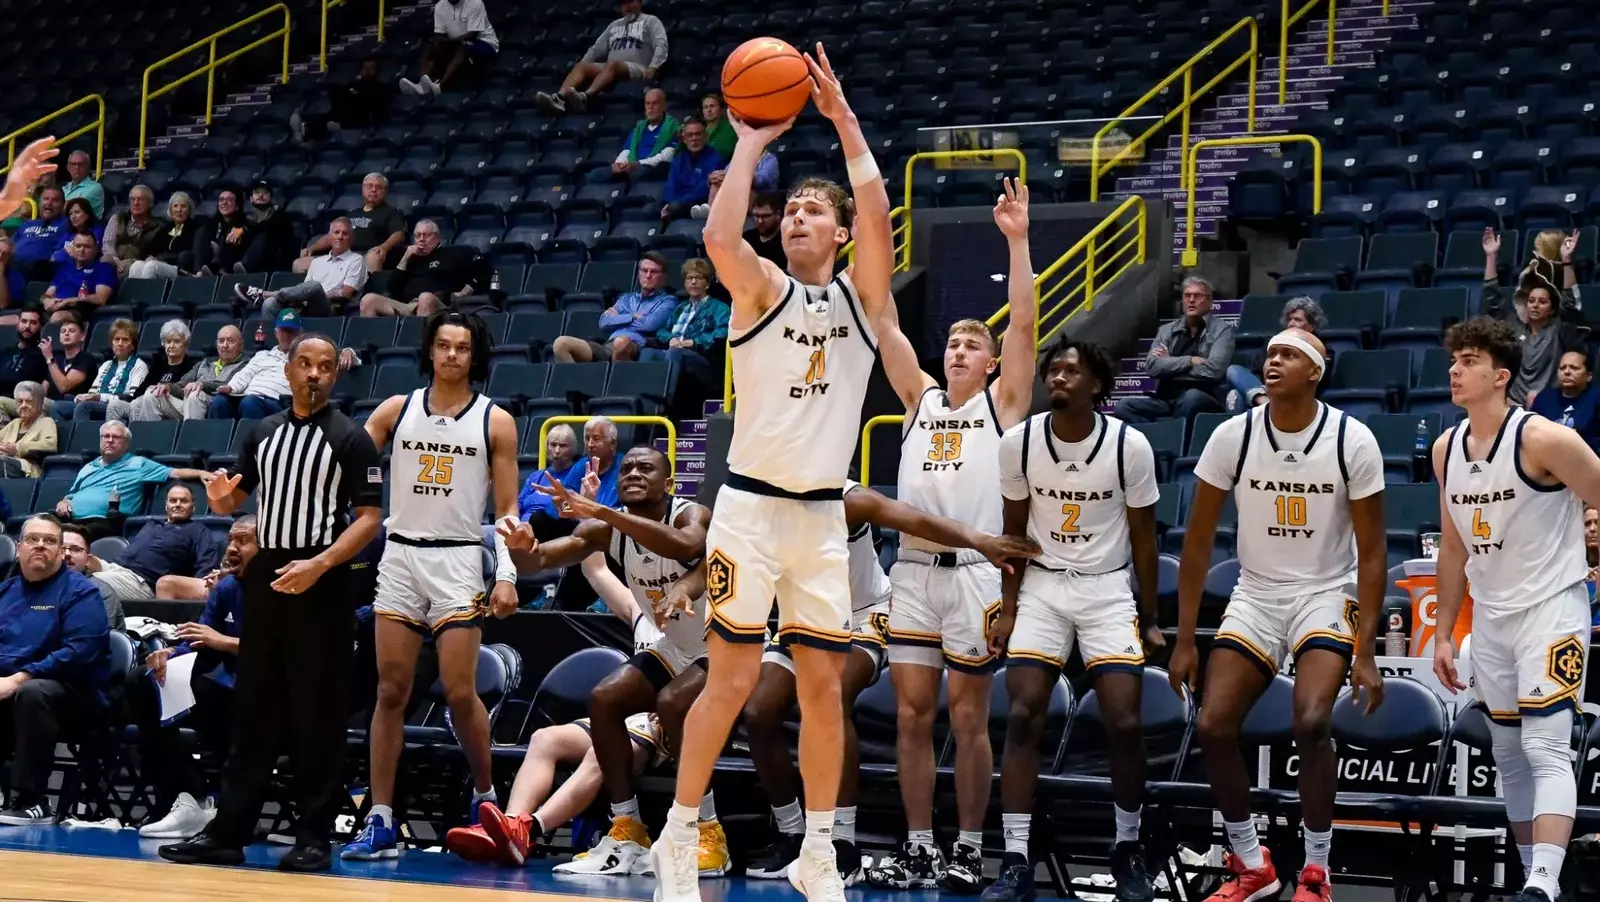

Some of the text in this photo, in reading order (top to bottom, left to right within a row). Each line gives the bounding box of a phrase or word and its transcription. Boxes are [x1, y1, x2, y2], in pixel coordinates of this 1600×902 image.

[1198, 205, 1221, 214] metro
[783, 326, 849, 347] KANAS
[805, 346, 826, 385] 11
[789, 383, 830, 399] CITY
[1115, 379, 1141, 389] metro
[919, 419, 985, 431] KANSAS
[401, 440, 478, 457] KANSAS
[927, 432, 962, 461] 33
[417, 454, 454, 485] 25
[686, 461, 705, 472] metr
[922, 462, 963, 471] CITY
[413, 485, 454, 497] CITY
[1034, 486, 1114, 501] KANSAS
[1249, 479, 1334, 493] KANSAS
[1450, 488, 1516, 505] KANSAS
[1061, 503, 1081, 532] 2
[1275, 495, 1307, 526] 10
[1472, 508, 1491, 540] 4
[1050, 531, 1094, 543] CITY
[1268, 527, 1316, 538] CITY
[1286, 755, 1400, 783] OICIAL
[1406, 762, 1458, 786] LIE
